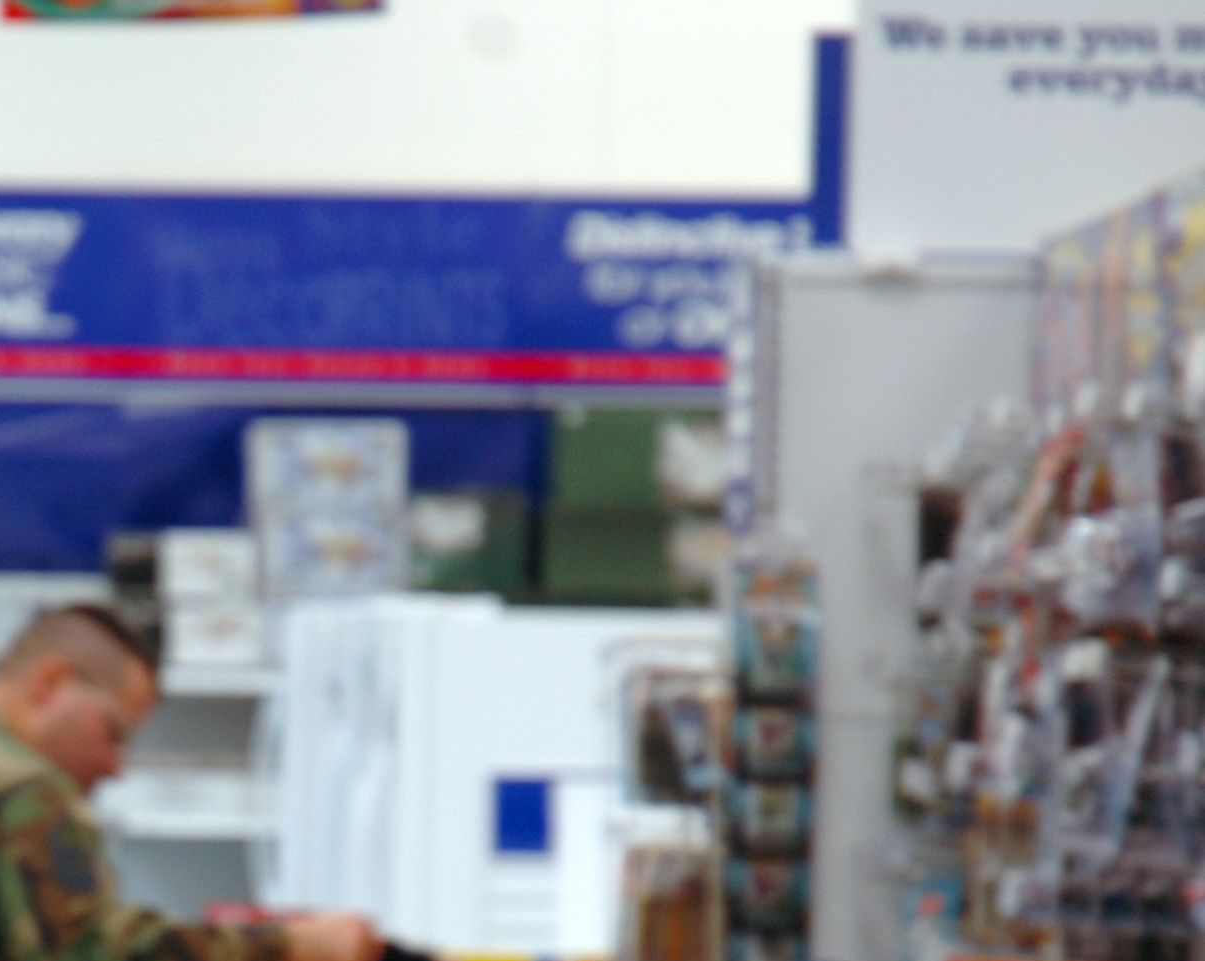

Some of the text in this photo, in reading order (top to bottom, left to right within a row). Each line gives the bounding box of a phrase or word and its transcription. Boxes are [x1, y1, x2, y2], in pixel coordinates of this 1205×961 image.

[882, 16, 946, 49] We
[961, 23, 1064, 51] save
[1076, 23, 1160, 60] you
